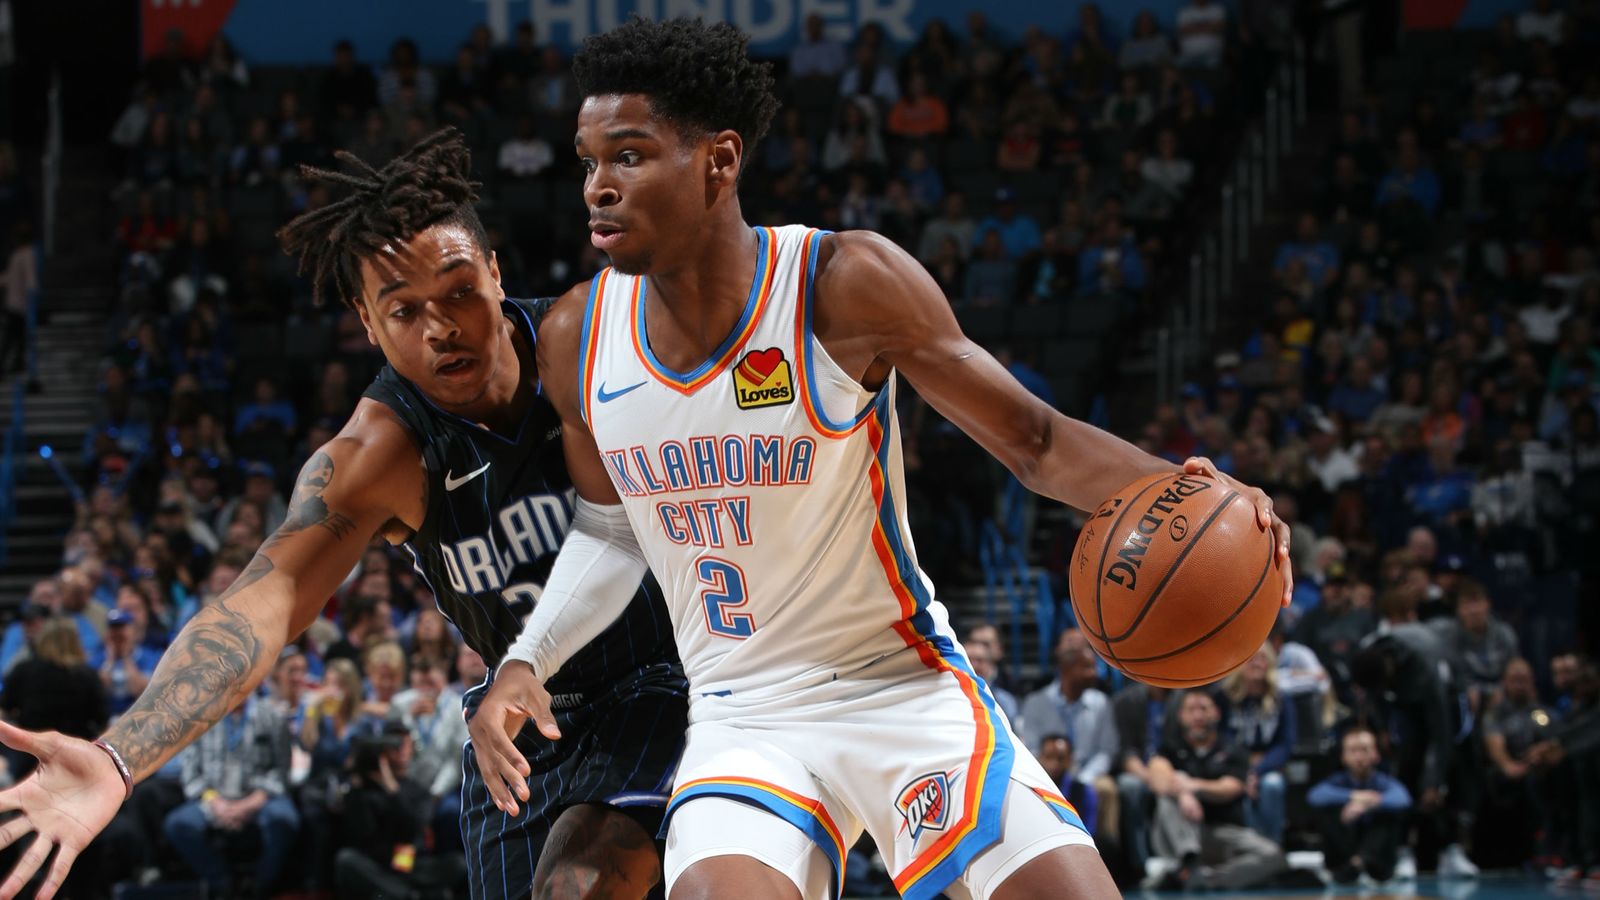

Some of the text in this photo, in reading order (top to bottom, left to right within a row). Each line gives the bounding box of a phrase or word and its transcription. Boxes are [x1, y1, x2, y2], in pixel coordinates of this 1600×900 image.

[440, 487, 578, 594] ORLAN
[656, 496, 753, 548] CITY
[695, 555, 757, 641] 2
[906, 779, 939, 838] OKC
